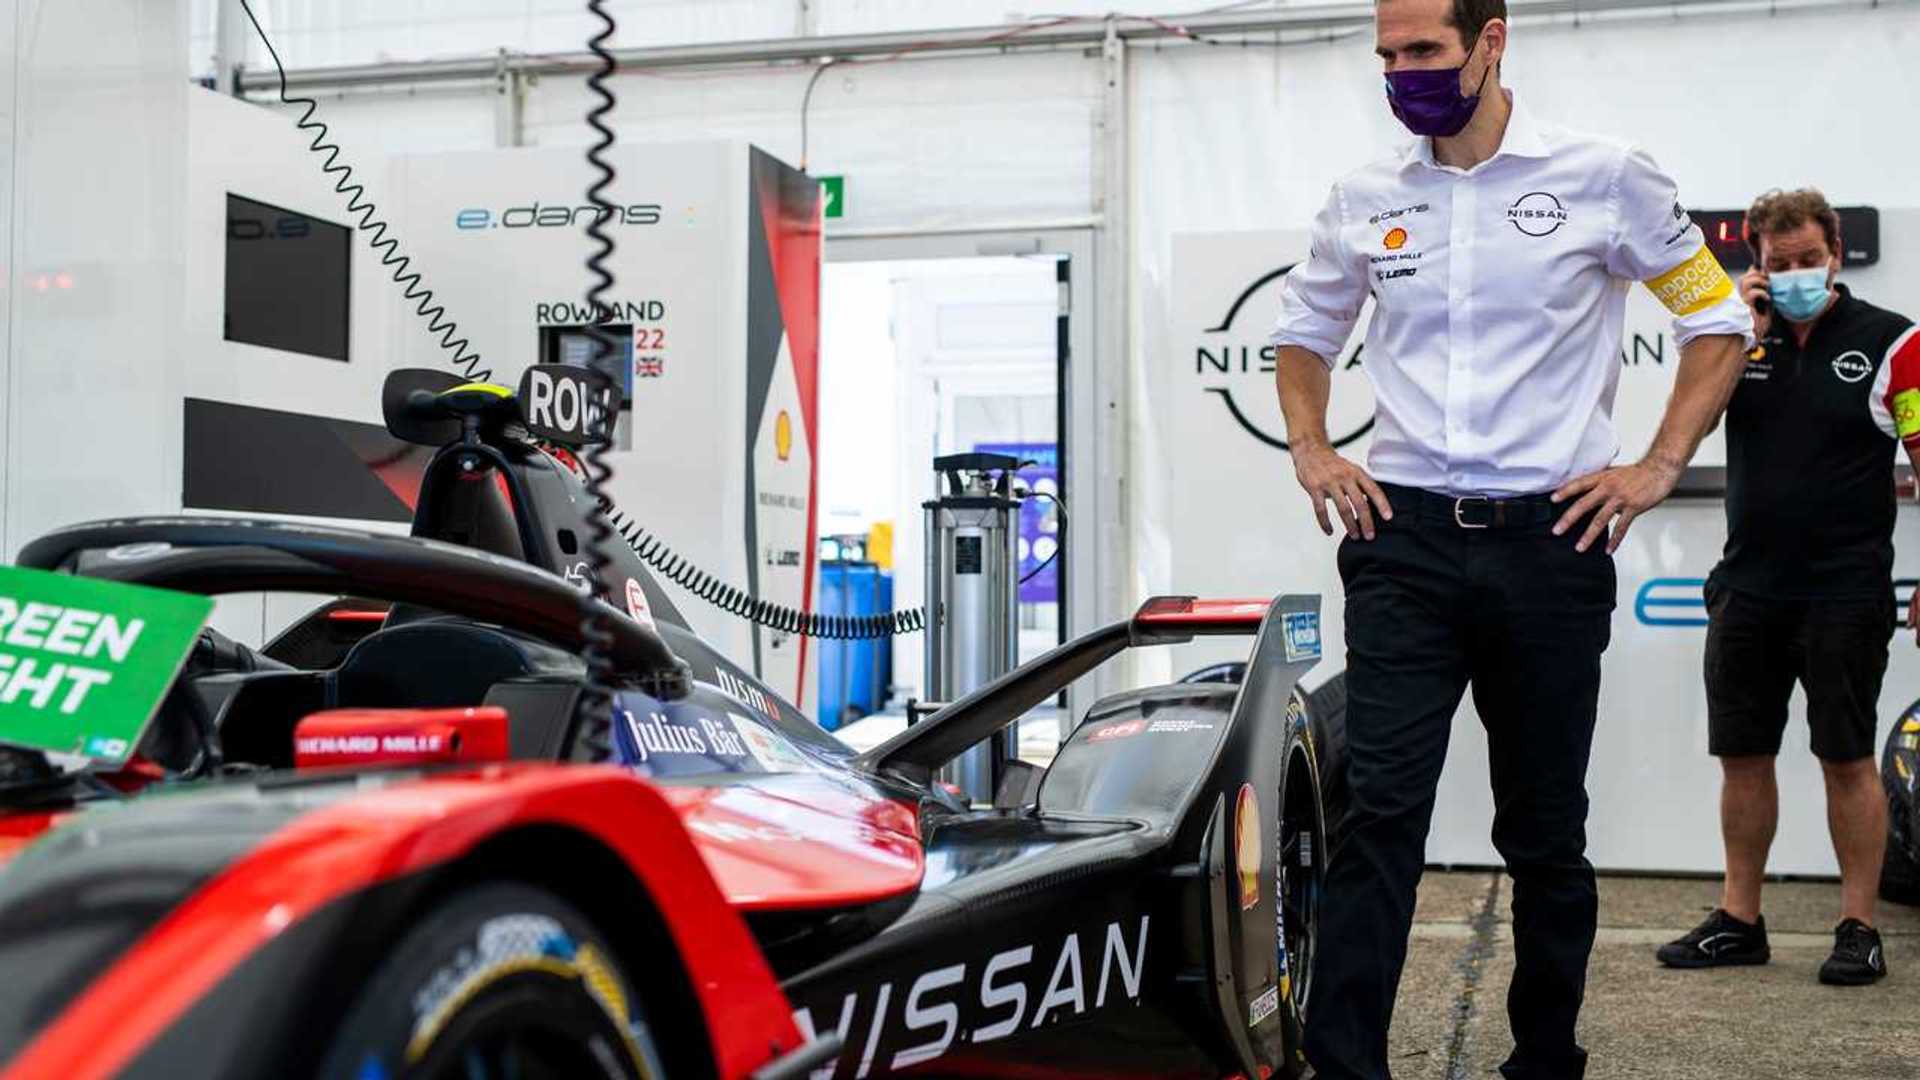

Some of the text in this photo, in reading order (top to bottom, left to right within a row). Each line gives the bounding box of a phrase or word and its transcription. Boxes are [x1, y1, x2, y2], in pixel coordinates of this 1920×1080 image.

[1507, 209, 1567, 221] NISSAN
[1655, 254, 1714, 301] ADDOCK
[635, 328, 666, 350] 22
[528, 369, 612, 436] ROW
[382, 735, 442, 752] MILLE
[624, 710, 746, 762] Julius Bär
